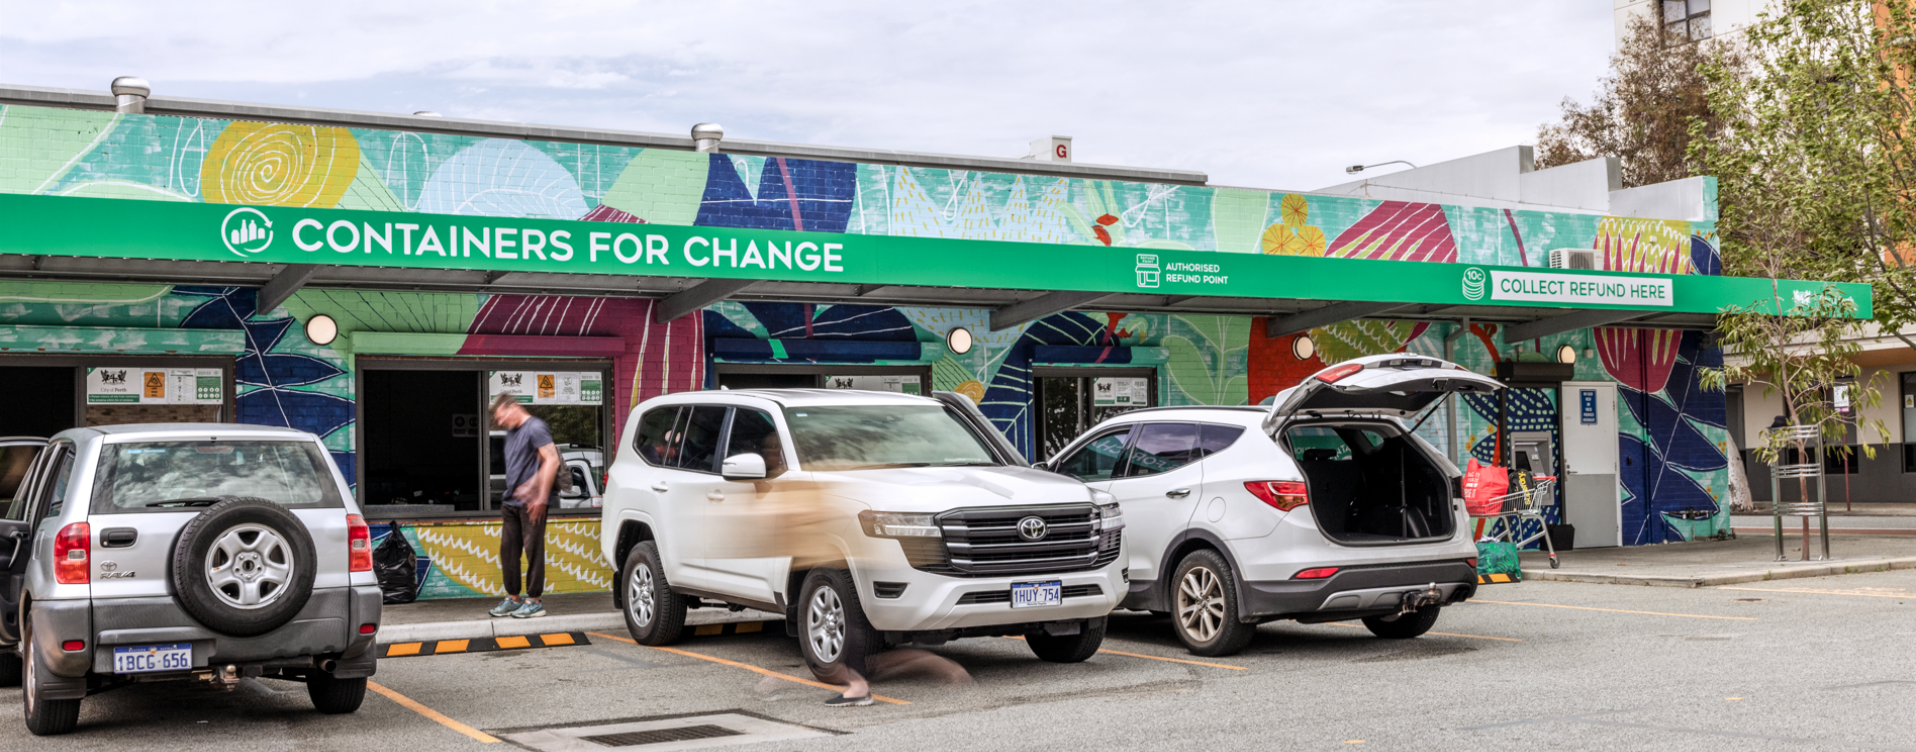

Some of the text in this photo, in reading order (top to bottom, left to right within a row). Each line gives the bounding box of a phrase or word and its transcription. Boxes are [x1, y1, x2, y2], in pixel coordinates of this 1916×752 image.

[1056, 144, 1067, 159] G
[292, 218, 844, 272] CONTAINERS FOR CHANGE
[1165, 262, 1220, 273] AUTHORISED
[1166, 273, 1228, 284] REFUND POINT
[1466, 270, 1482, 281] 10c
[1500, 278, 1665, 299] COLLECT REFUND HERE
[100, 570, 136, 579] RAV4
[118, 652, 188, 671] 1BCG-656
